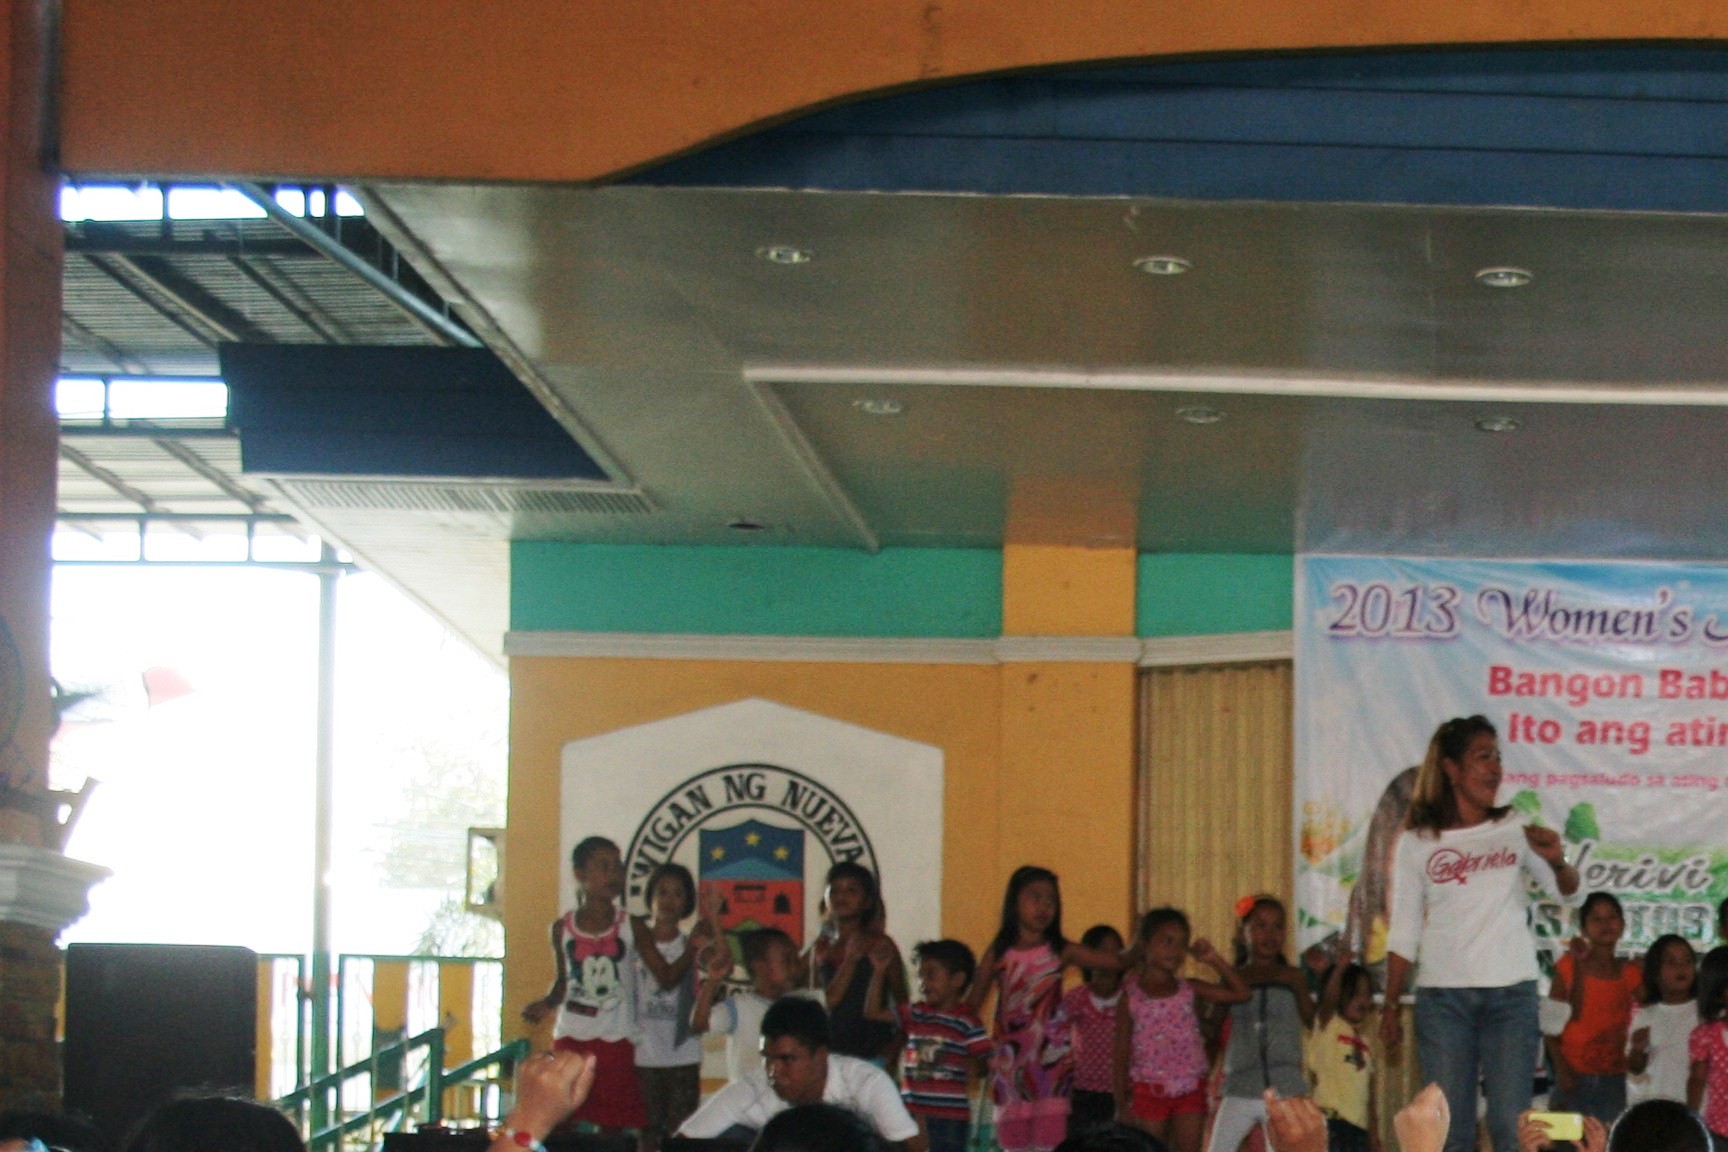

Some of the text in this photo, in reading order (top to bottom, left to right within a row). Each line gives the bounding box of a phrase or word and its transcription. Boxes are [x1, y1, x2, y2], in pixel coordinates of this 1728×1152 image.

[1328, 582, 1460, 637] 2013
[1477, 586, 1691, 640] Women's
[1488, 665, 1643, 706] Bangon
[1508, 712, 1562, 744] Ito
[1575, 720, 1651, 755] ang
[722, 772, 767, 802] NG
